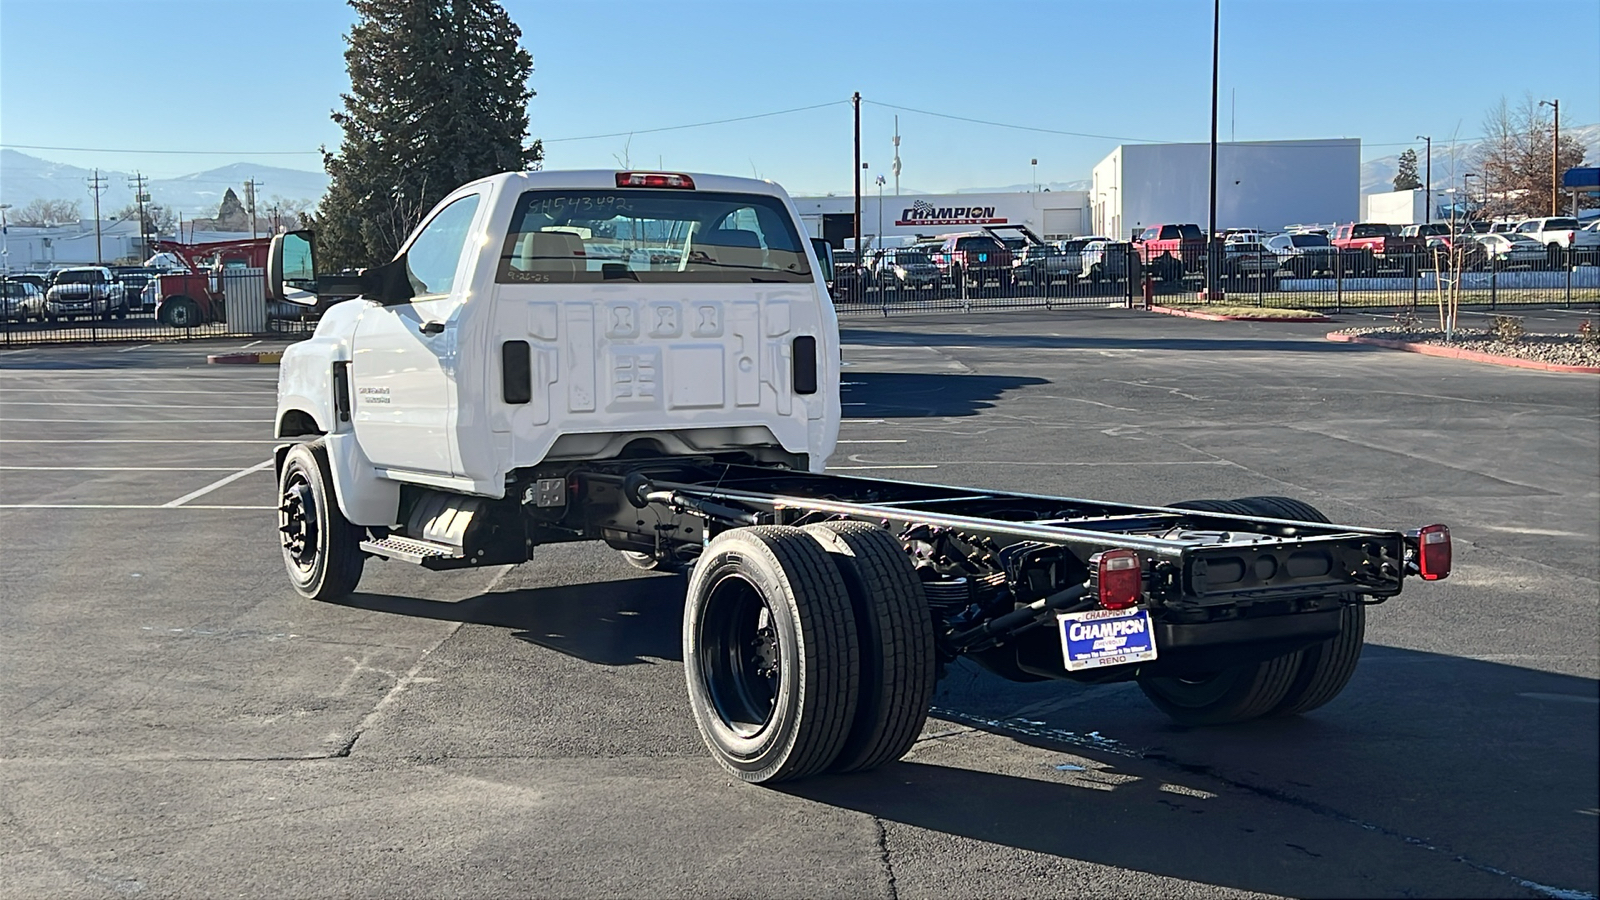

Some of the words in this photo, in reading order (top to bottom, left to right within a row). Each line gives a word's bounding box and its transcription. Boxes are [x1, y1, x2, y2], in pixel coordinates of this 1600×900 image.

[902, 206, 996, 223] CHAMPION
[1085, 609, 1127, 620] CHAMPION
[1069, 618, 1145, 642] CHAMPION
[1098, 655, 1127, 665] RENO
